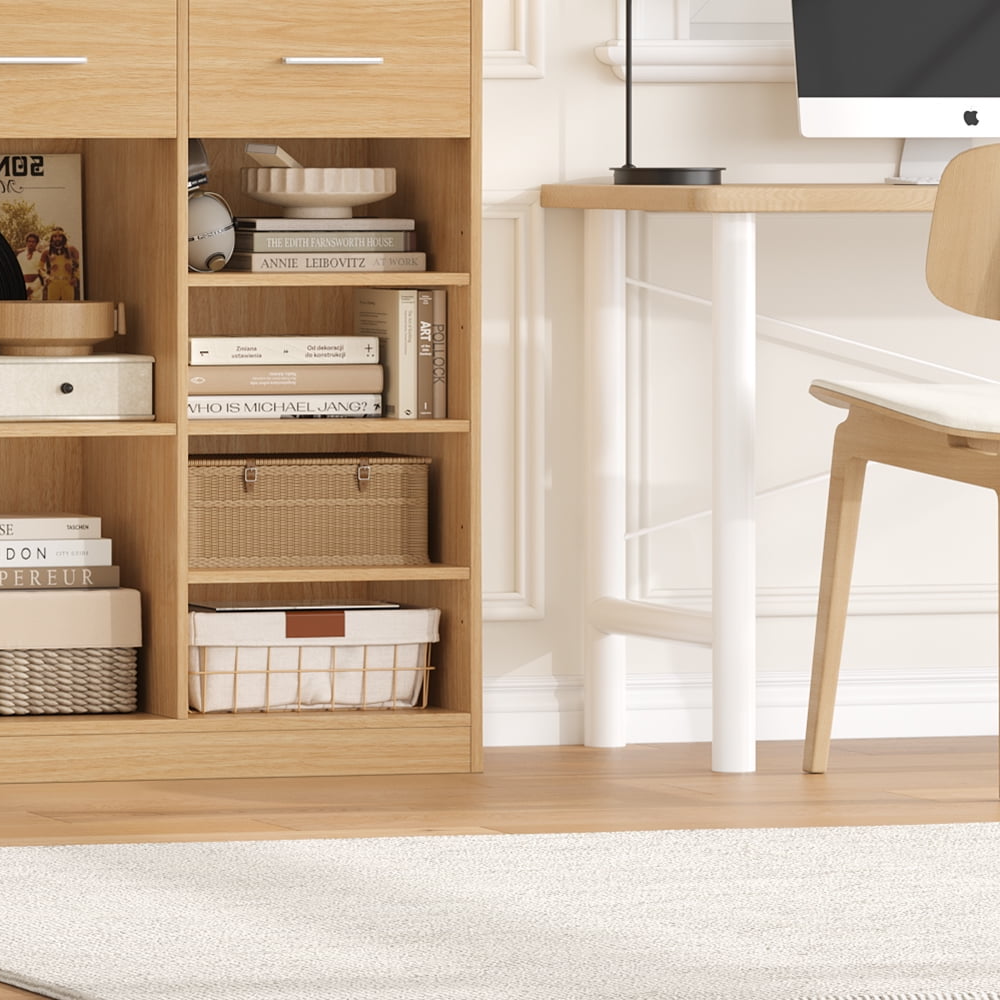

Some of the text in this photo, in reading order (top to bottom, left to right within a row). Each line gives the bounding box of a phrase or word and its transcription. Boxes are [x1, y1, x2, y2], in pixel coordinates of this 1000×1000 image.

[266, 237, 394, 248] THE EDITH FARNSWORTH HOUSE
[260, 257, 418, 269] ANNIE LEIBOVITZ AT WORK
[420, 320, 431, 342] ART
[432, 324, 445, 384] POLLOCK
[226, 403, 240, 412] IS
[243, 402, 317, 412] MICHAEL
[317, 401, 368, 412] JANG?
